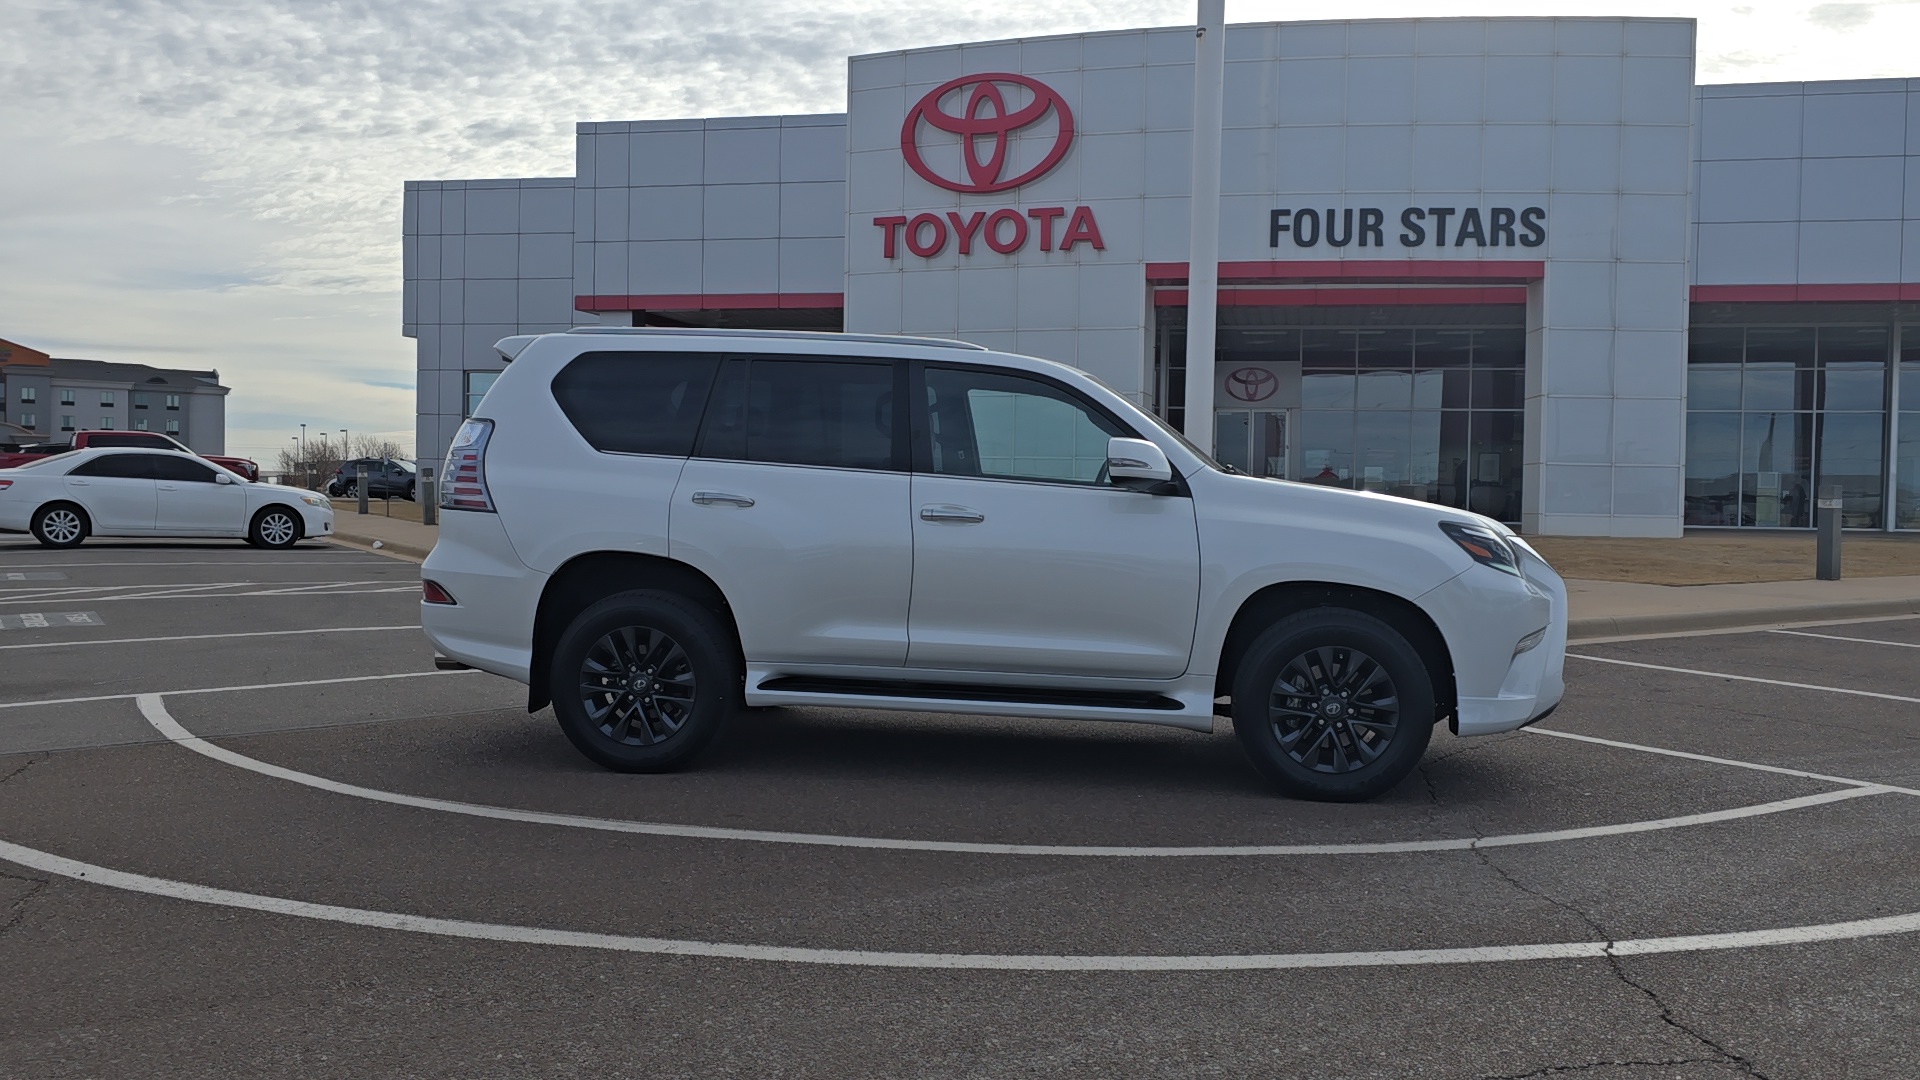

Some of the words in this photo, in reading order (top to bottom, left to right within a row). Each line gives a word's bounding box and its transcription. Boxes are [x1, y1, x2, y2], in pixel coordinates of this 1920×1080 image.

[873, 206, 1105, 259] TOYOTA
[1269, 208, 1384, 248] FOUR
[1399, 207, 1546, 248] STARS
